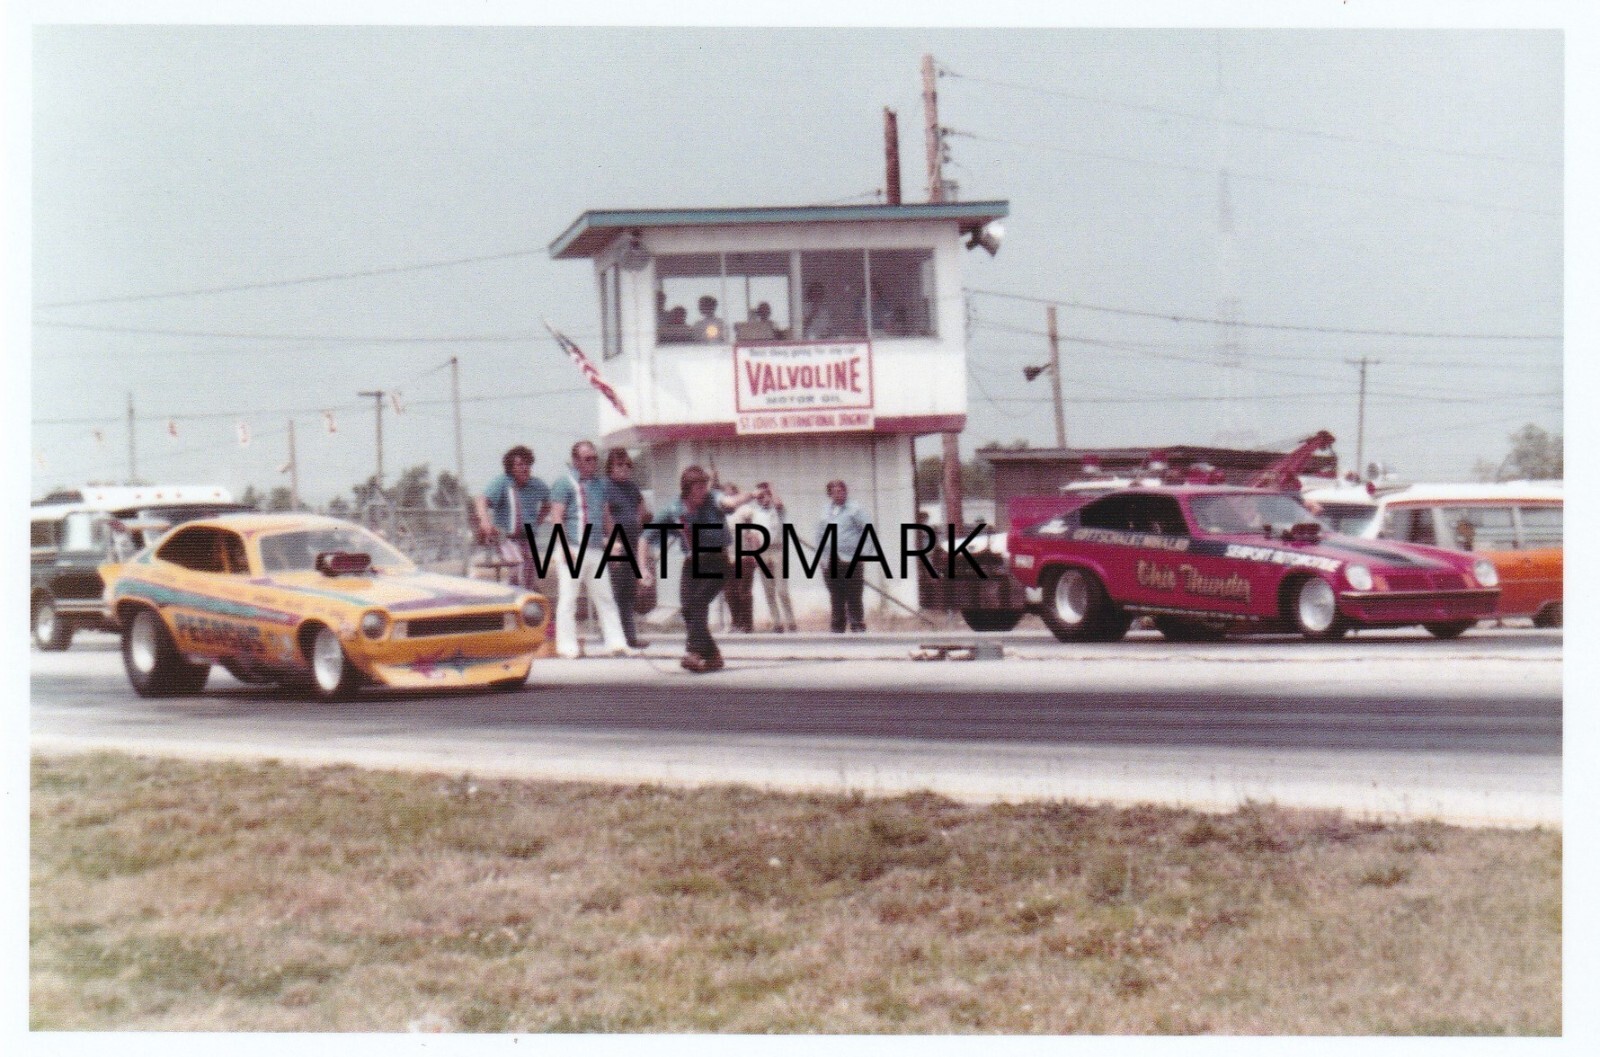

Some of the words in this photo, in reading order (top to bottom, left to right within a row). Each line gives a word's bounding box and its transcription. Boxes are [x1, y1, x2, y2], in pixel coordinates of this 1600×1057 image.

[745, 356, 862, 396] VALVOLINE
[766, 395, 814, 404] MOTOR
[821, 394, 842, 403] OIL
